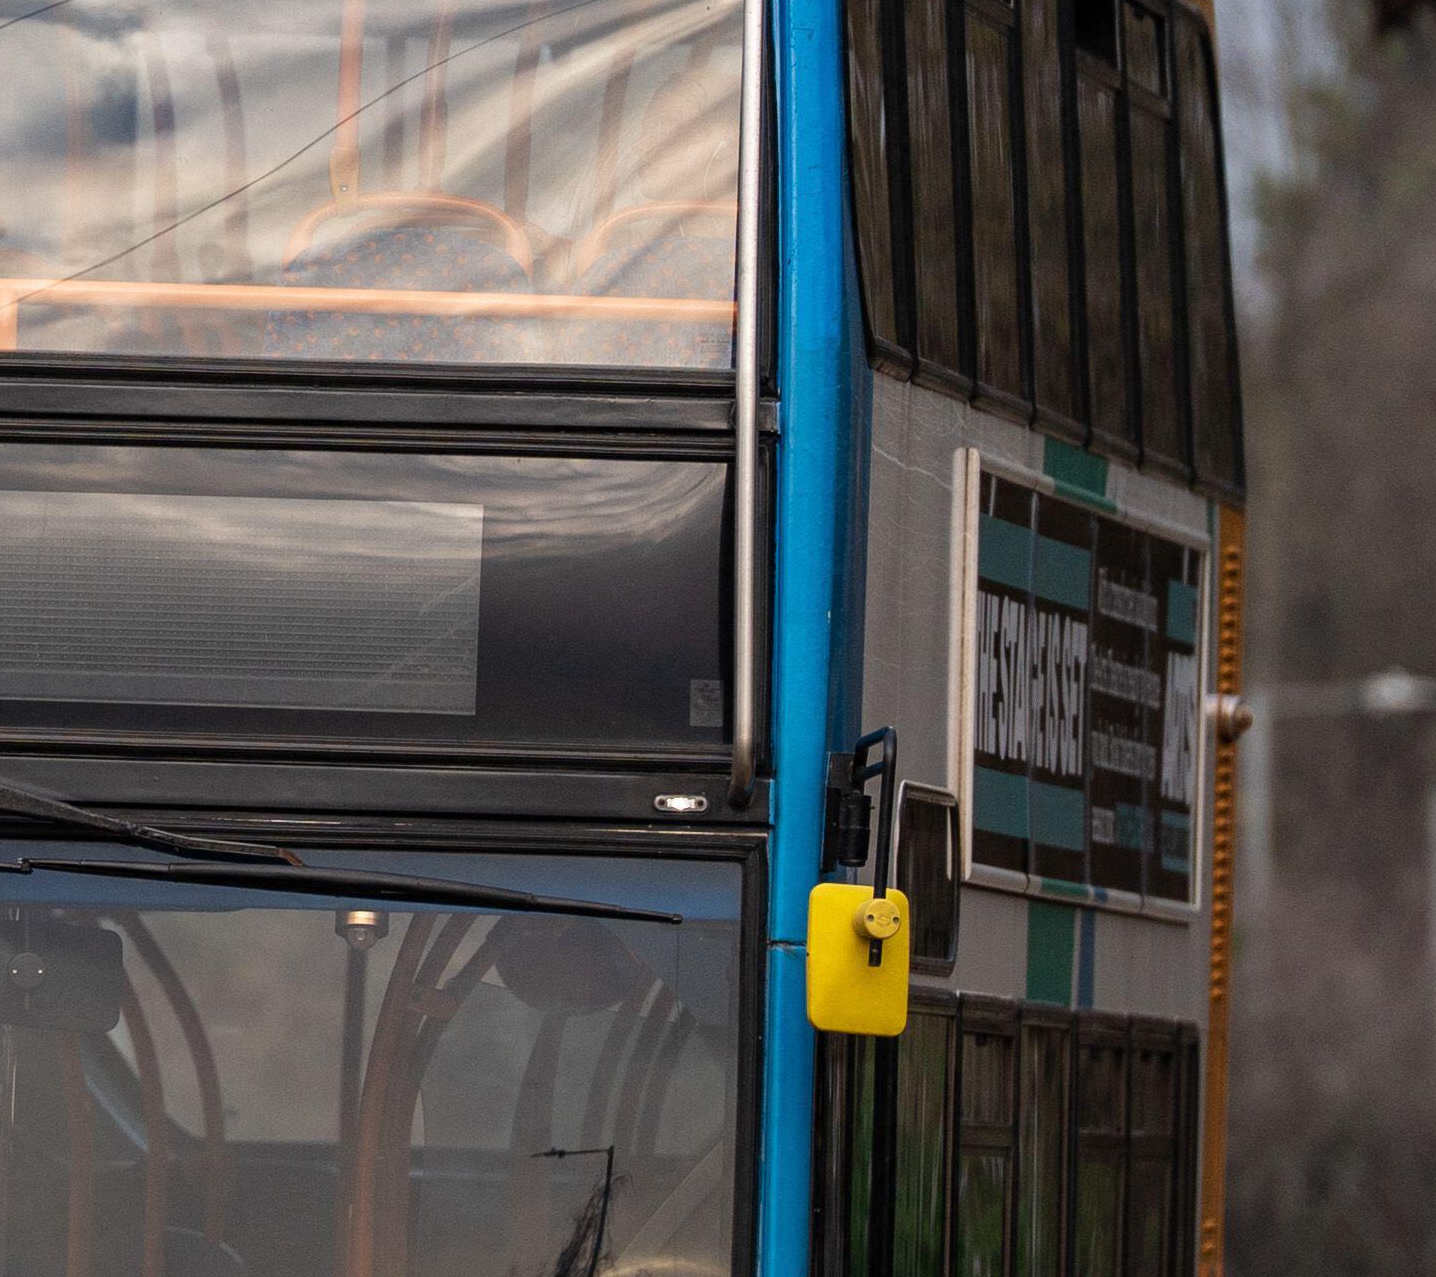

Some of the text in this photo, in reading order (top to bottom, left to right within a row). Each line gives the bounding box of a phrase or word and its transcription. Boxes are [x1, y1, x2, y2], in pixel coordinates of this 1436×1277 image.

[974, 591, 1000, 756] THE
[998, 595, 1046, 769] STAGE
[1043, 612, 1061, 775] IS
[1059, 615, 1088, 777] SET
